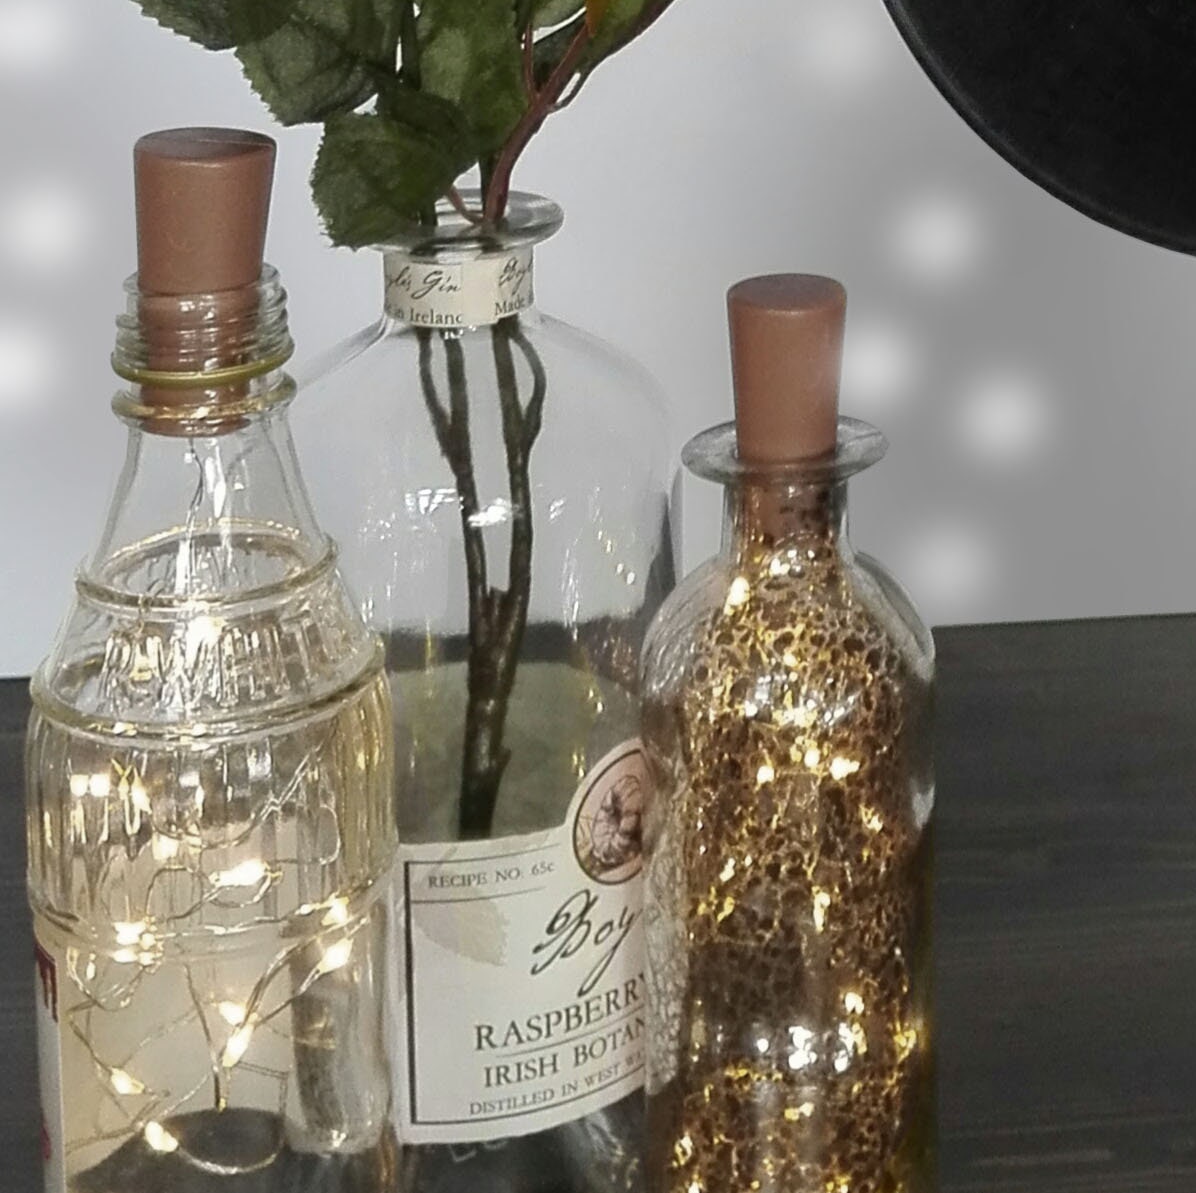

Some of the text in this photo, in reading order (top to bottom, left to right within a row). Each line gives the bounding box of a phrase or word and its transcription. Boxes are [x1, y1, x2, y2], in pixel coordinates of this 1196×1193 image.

[410, 270, 462, 300] Gin
[427, 871, 488, 889] RECIPE
[484, 1053, 560, 1088] IRISH
[469, 1062, 620, 1115] DISTILLED IN WEST
